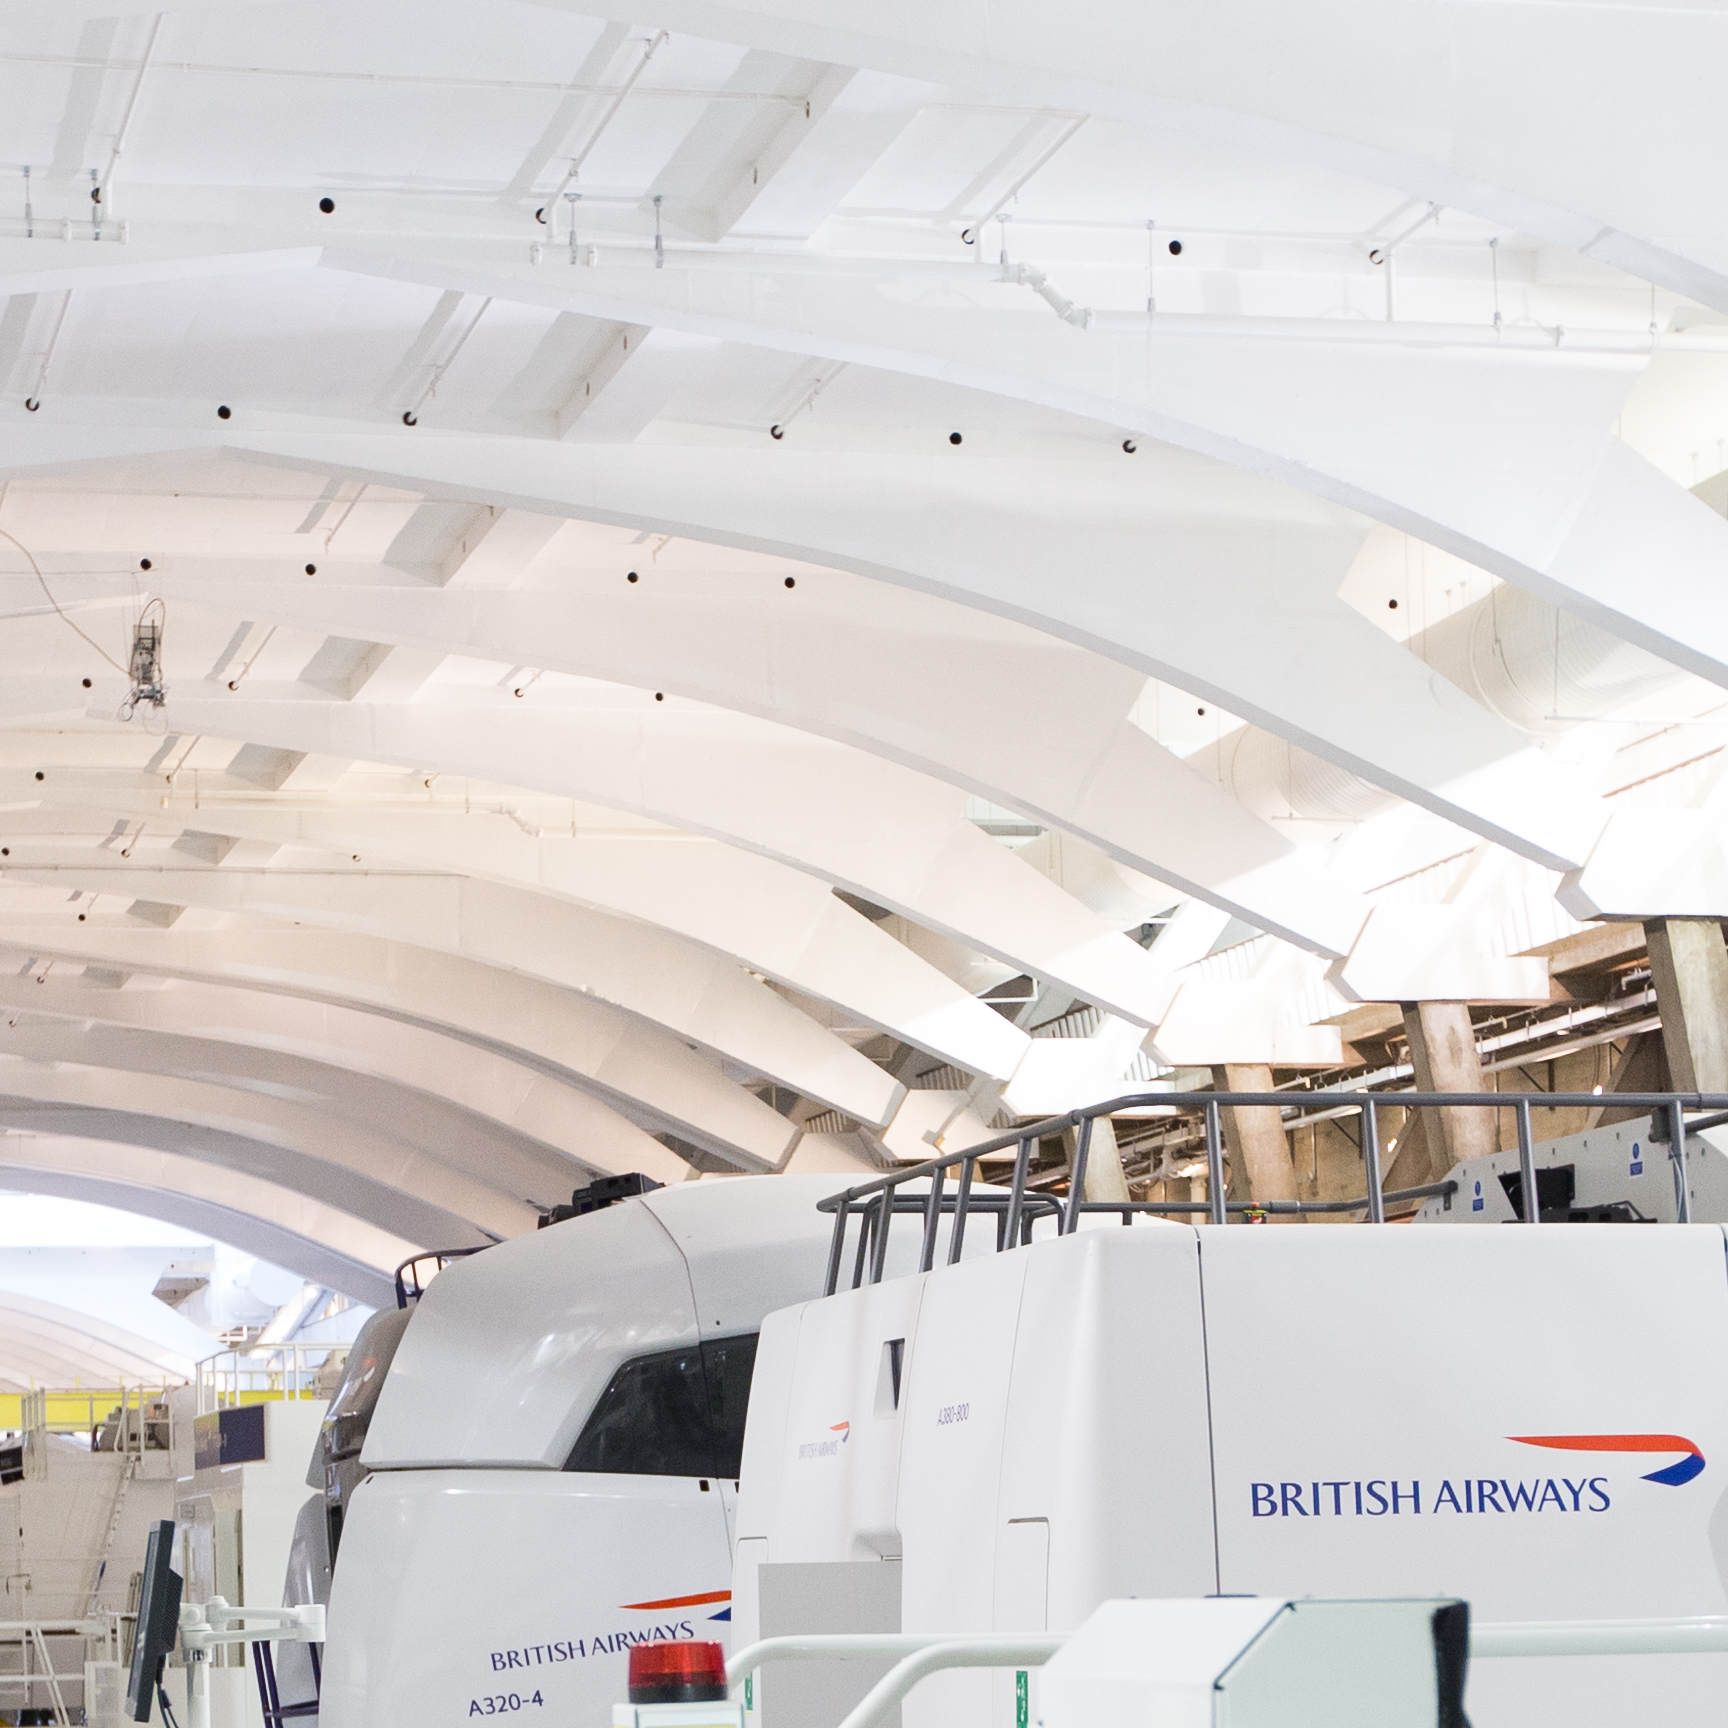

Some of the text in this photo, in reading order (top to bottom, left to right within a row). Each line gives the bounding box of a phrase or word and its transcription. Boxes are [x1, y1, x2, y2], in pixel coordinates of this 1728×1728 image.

[936, 1403, 970, 1426] A380-800
[1250, 1477, 1611, 1518] BRITISH AIRWAYS
[490, 1620, 695, 1672] BRITISH AIRWAYS
[468, 1689, 545, 1718] A320-4
